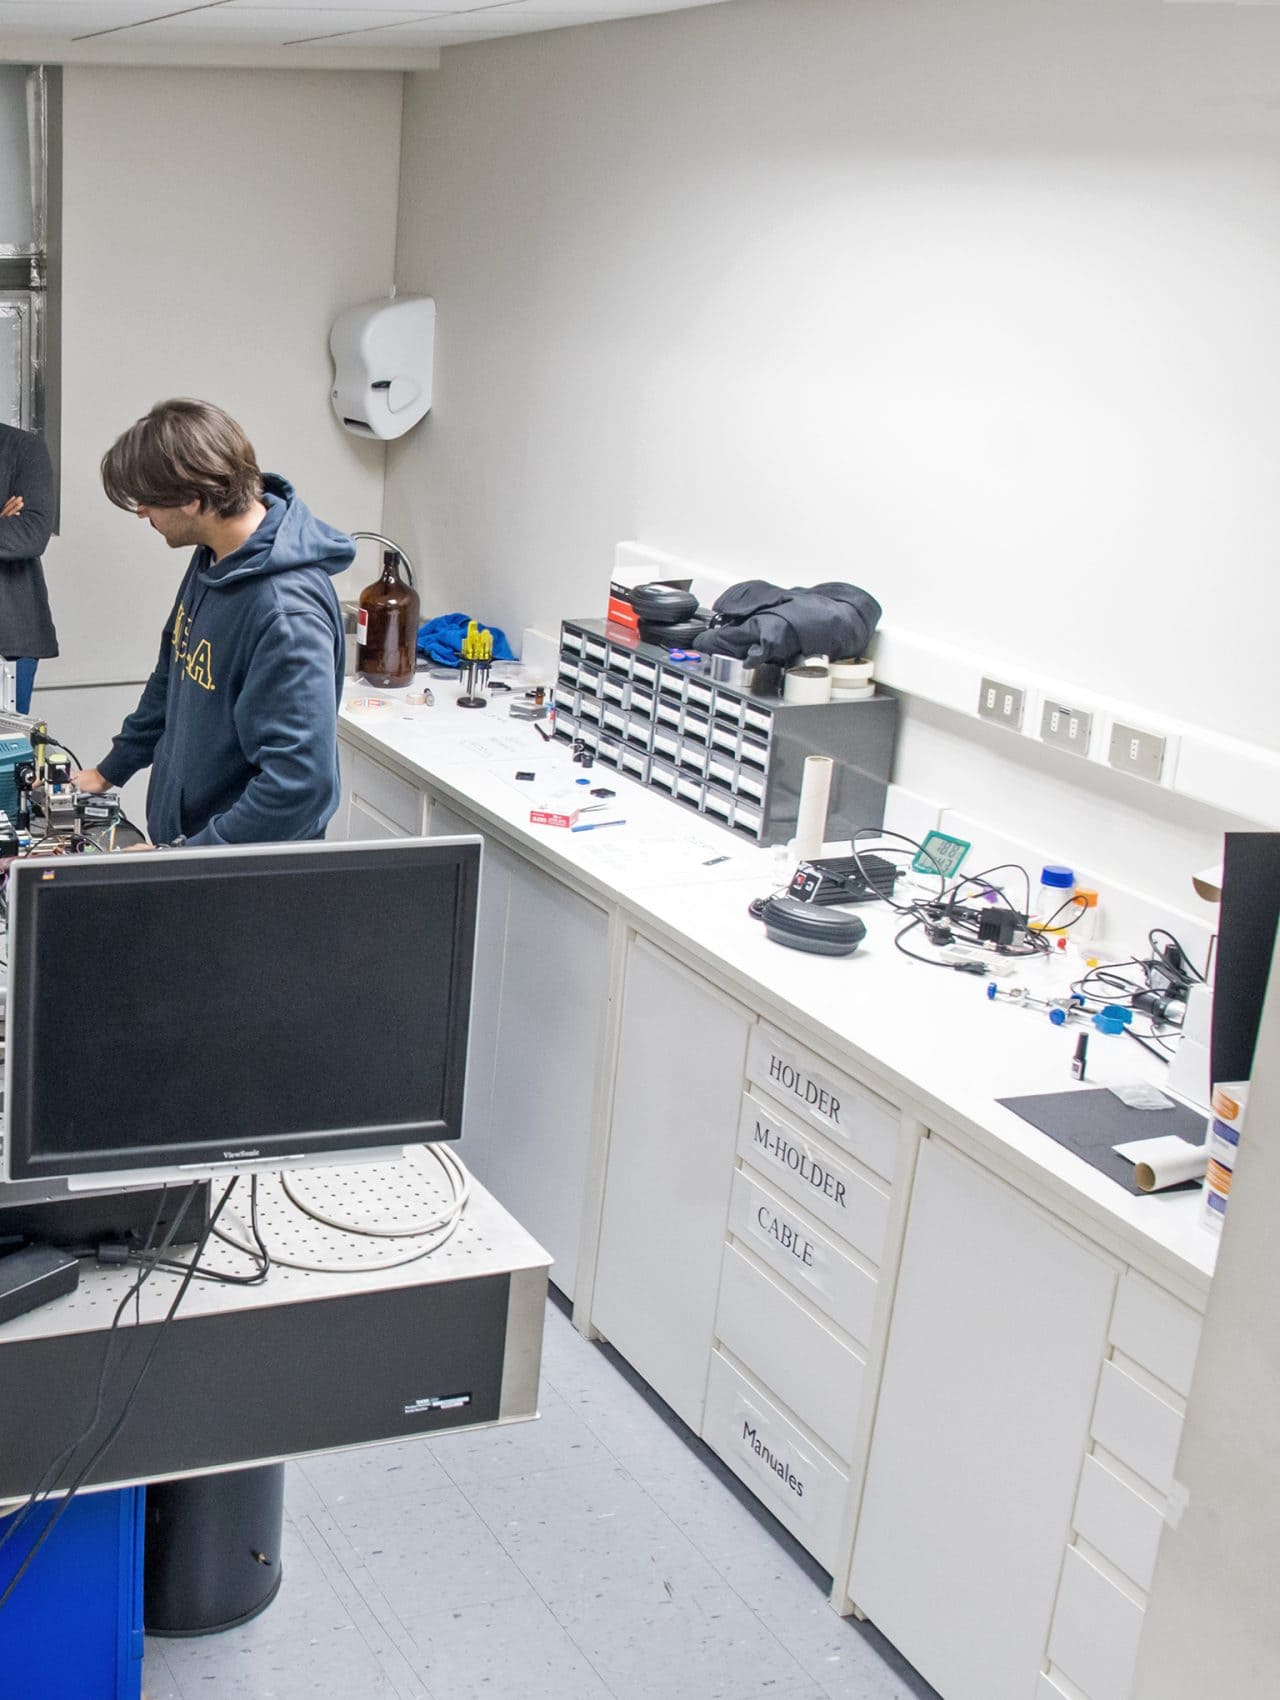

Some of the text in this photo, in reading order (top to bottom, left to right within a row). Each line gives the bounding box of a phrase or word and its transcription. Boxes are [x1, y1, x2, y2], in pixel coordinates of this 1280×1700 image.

[770, 1054, 841, 1123] HOLDER
[753, 1120, 847, 1209] M-HOLDER
[757, 1206, 814, 1268] CABLE
[742, 1420, 804, 1498] Manuales
